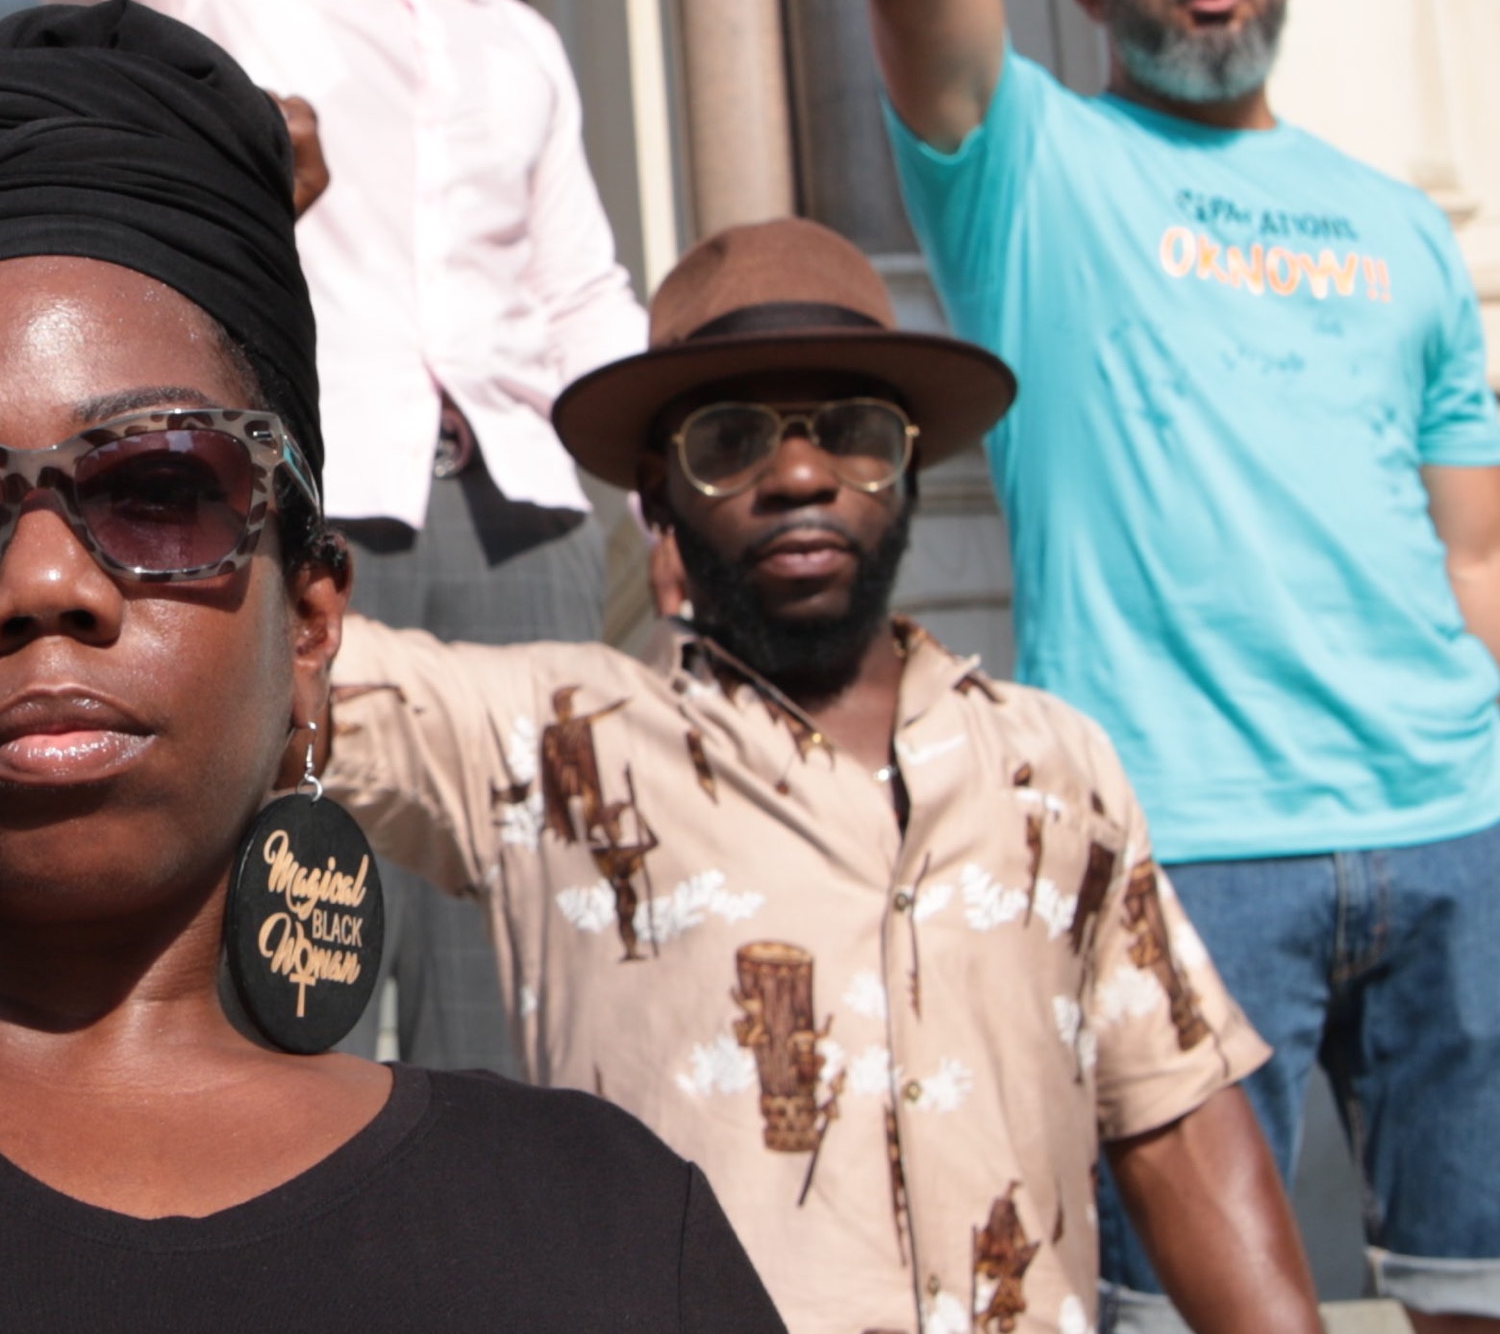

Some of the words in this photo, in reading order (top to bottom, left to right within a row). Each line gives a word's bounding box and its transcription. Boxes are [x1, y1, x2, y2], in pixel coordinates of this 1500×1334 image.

[263, 829, 370, 921] Magical
[258, 912, 361, 1017] Woman
[312, 908, 364, 948] BLACK
